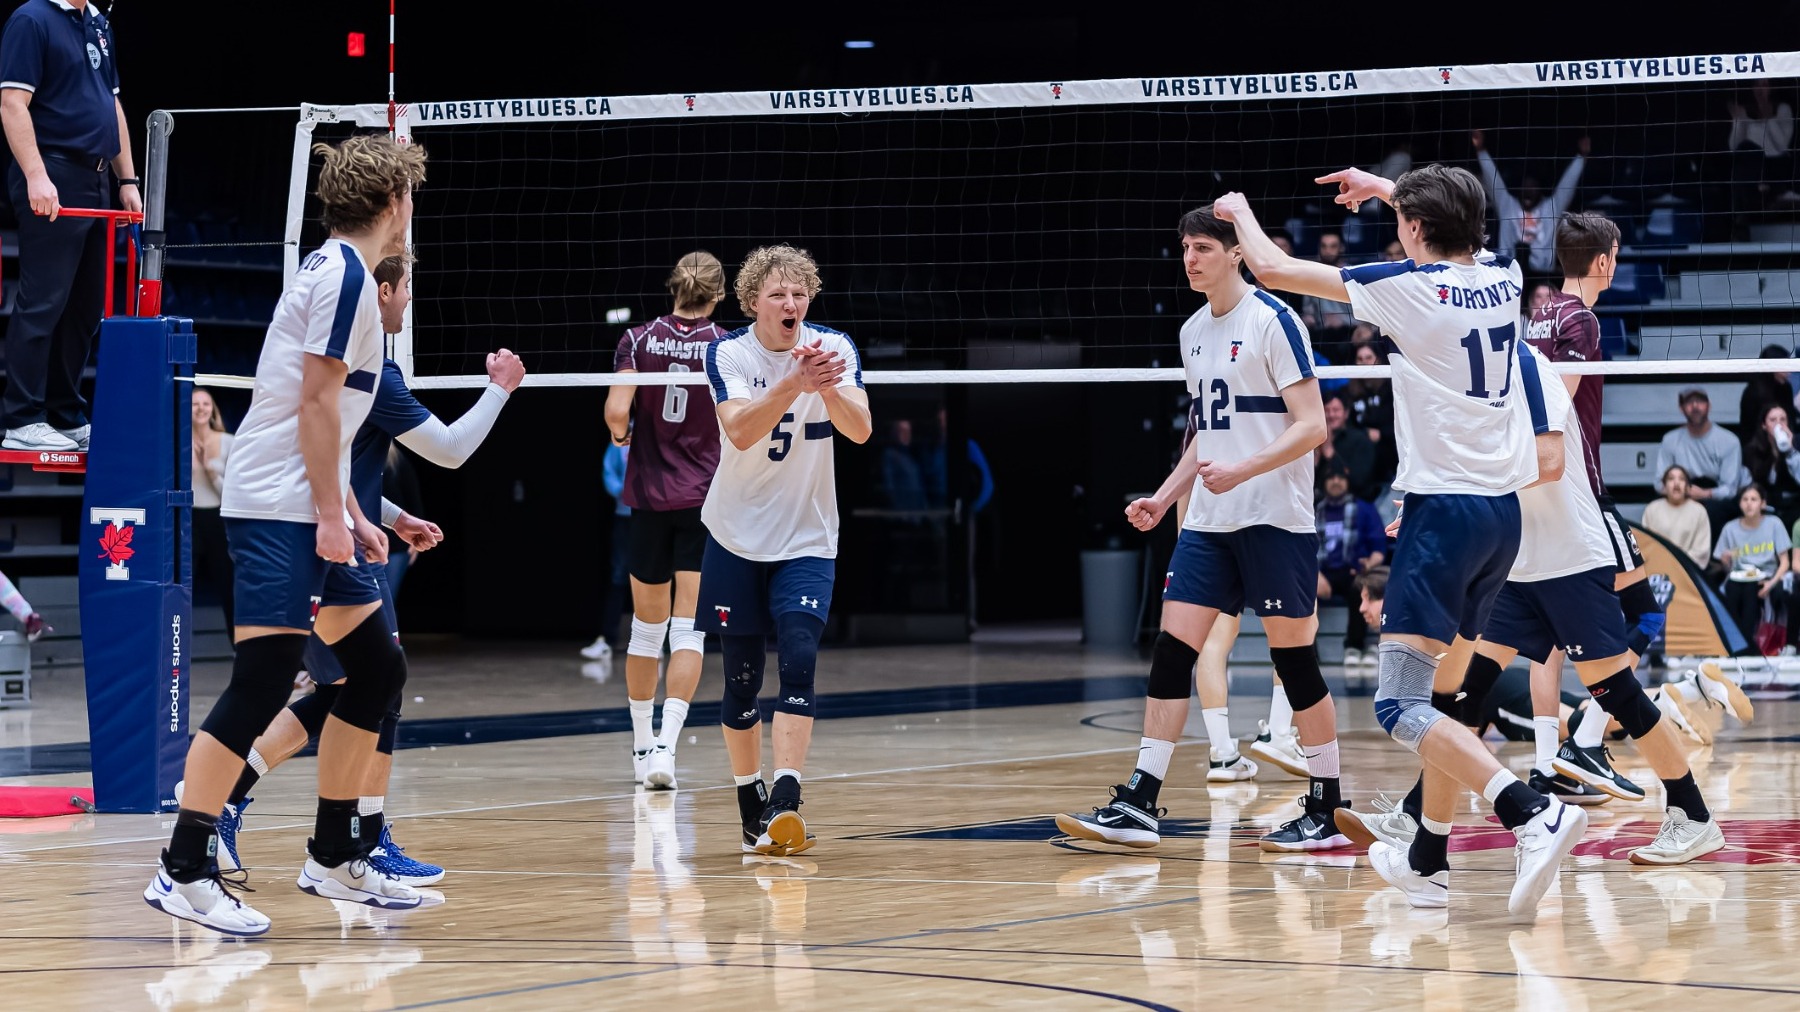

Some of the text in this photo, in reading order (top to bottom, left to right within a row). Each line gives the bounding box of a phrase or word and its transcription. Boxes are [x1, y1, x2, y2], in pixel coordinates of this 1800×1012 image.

[1141, 72, 1358, 97] VARSITYBLUES.CA
[1536, 55, 1765, 82] VARSITYBLUES.CA
[419, 98, 612, 121] VARSITYBLUES.CA
[770, 86, 974, 109] VARSITYBLUES.CA
[1460, 320, 1516, 398] 17
[662, 362, 691, 423] 6
[1194, 378, 1230, 430] 12
[767, 412, 795, 462] 5
[50, 453, 79, 462] Senoh
[172, 614, 181, 666] sports
